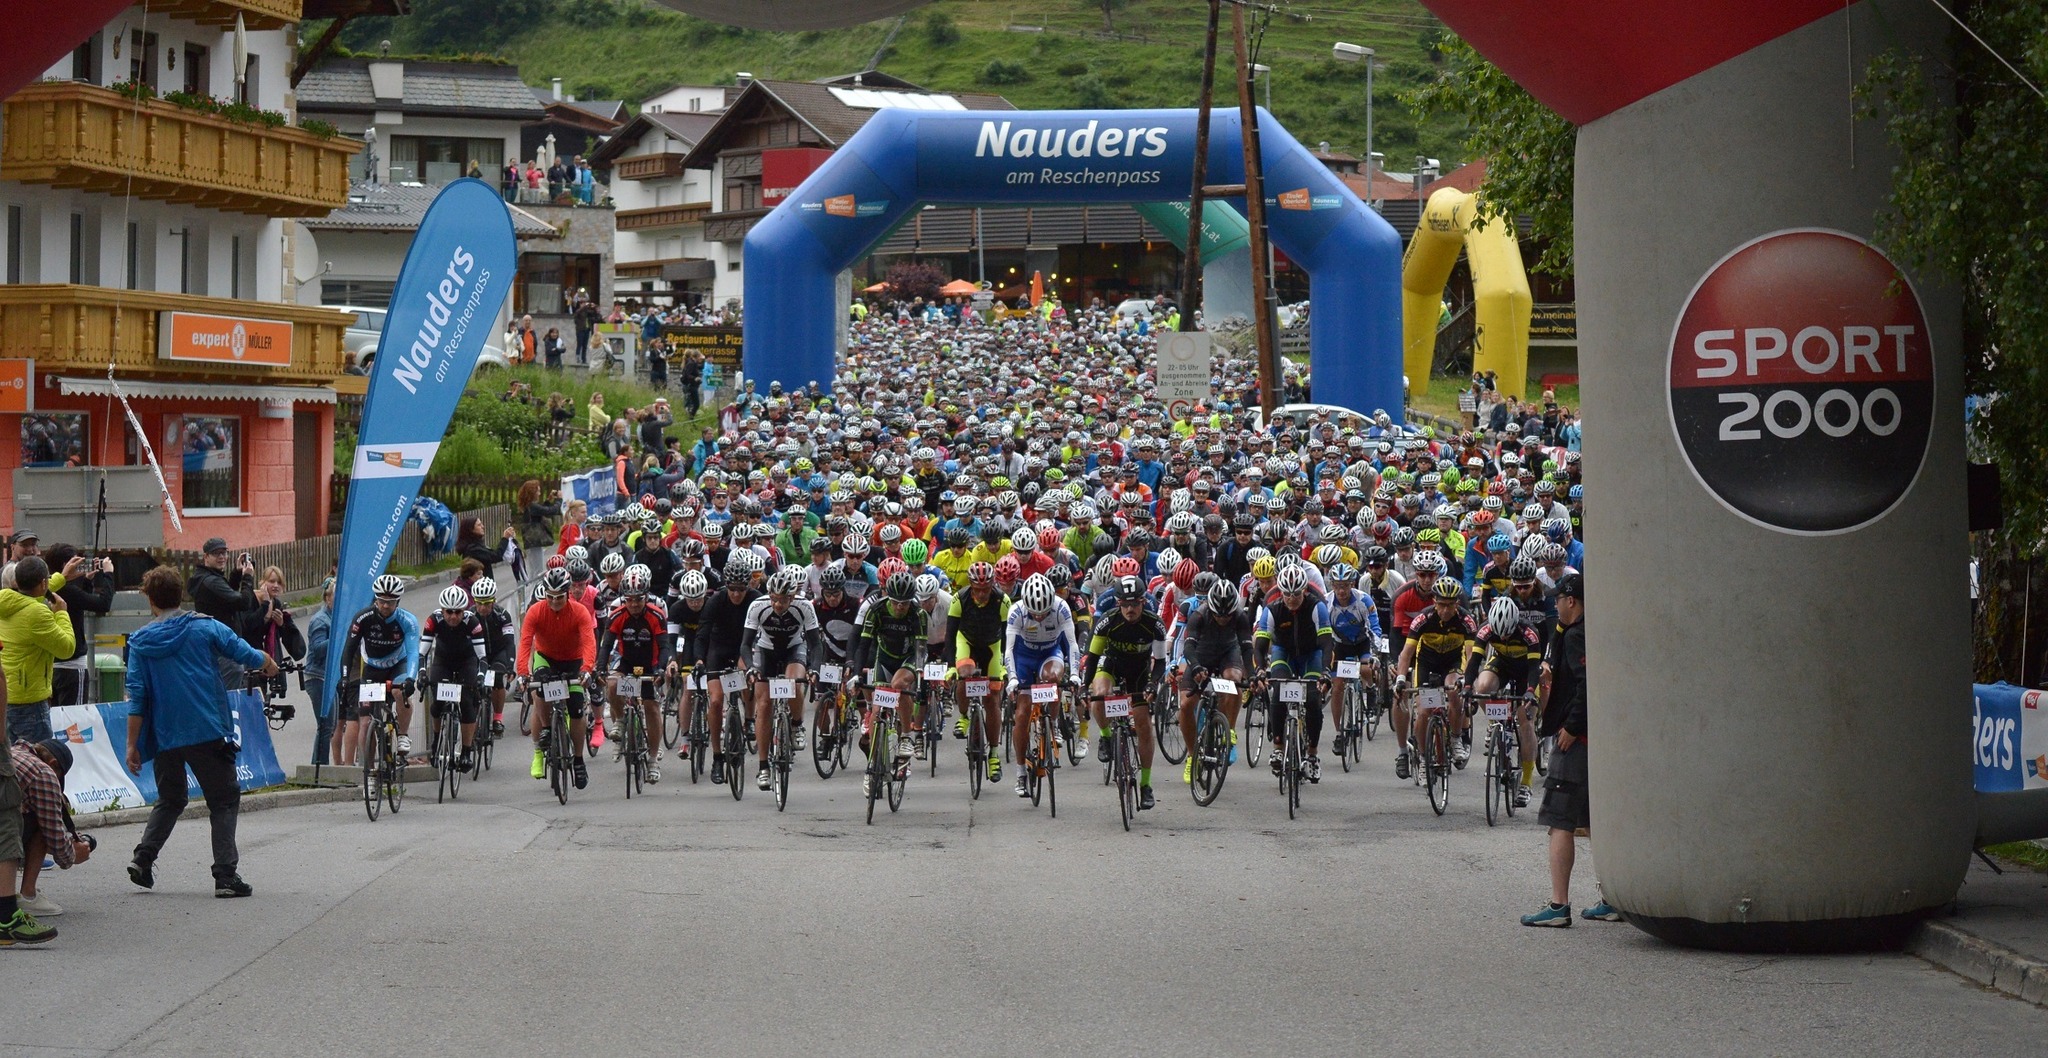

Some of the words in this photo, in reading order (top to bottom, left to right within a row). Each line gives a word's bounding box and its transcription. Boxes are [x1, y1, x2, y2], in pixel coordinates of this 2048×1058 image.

[975, 119, 1169, 158] Nauders
[1006, 171, 1034, 184] am
[1040, 167, 1161, 187] Reschenpass
[392, 245, 475, 395] Nauders
[435, 359, 450, 383] am
[443, 268, 491, 359] Reschenpass
[191, 332, 230, 348] expert
[248, 332, 272, 350] MÜLLER
[667, 332, 718, 345] Restaurant
[1693, 325, 1915, 378] SPORT
[1174, 388, 1194, 396] Zone
[1718, 387, 1902, 441] 2000
[367, 494, 408, 578] nauders.com
[548, 688, 562, 698] 103
[875, 693, 895, 703] 2009
[1034, 691, 1053, 699] 2030
[1284, 690, 1299, 698] 135
[1107, 704, 1127, 713] 2530
[1487, 708, 1507, 716] 2024
[1973, 696, 2015, 770] ders
[75, 786, 131, 803] nauders.com
